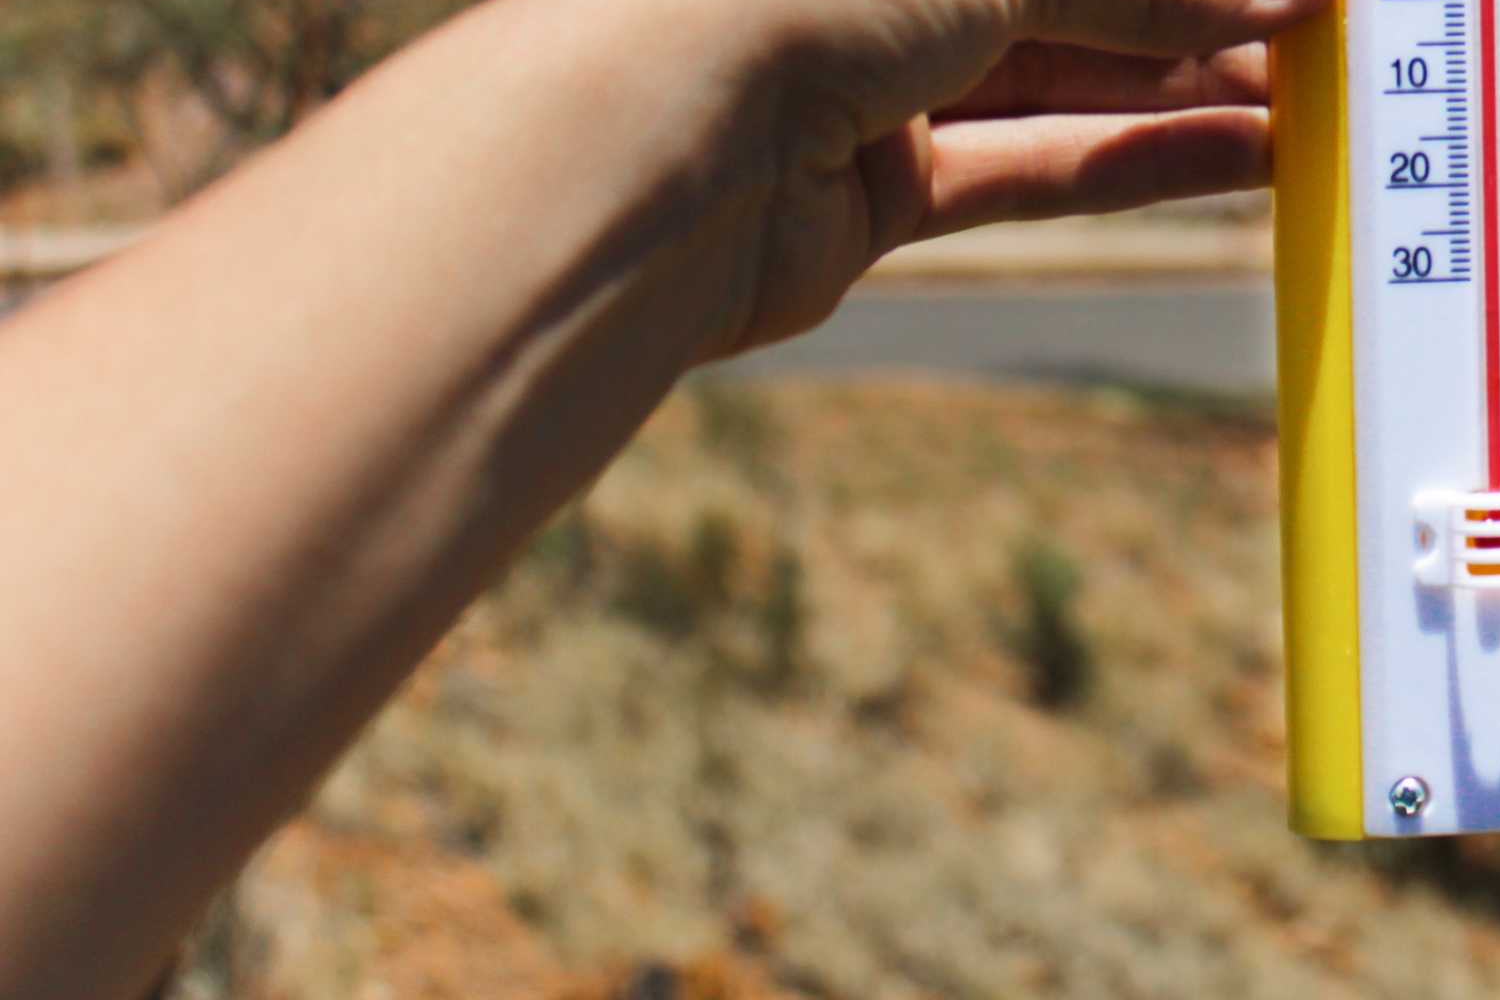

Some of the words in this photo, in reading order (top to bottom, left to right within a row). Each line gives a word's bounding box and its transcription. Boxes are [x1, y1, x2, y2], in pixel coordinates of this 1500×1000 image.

[1391, 58, 1427, 88] 10
[1390, 152, 1429, 182] 20
[1393, 247, 1431, 277] 30
